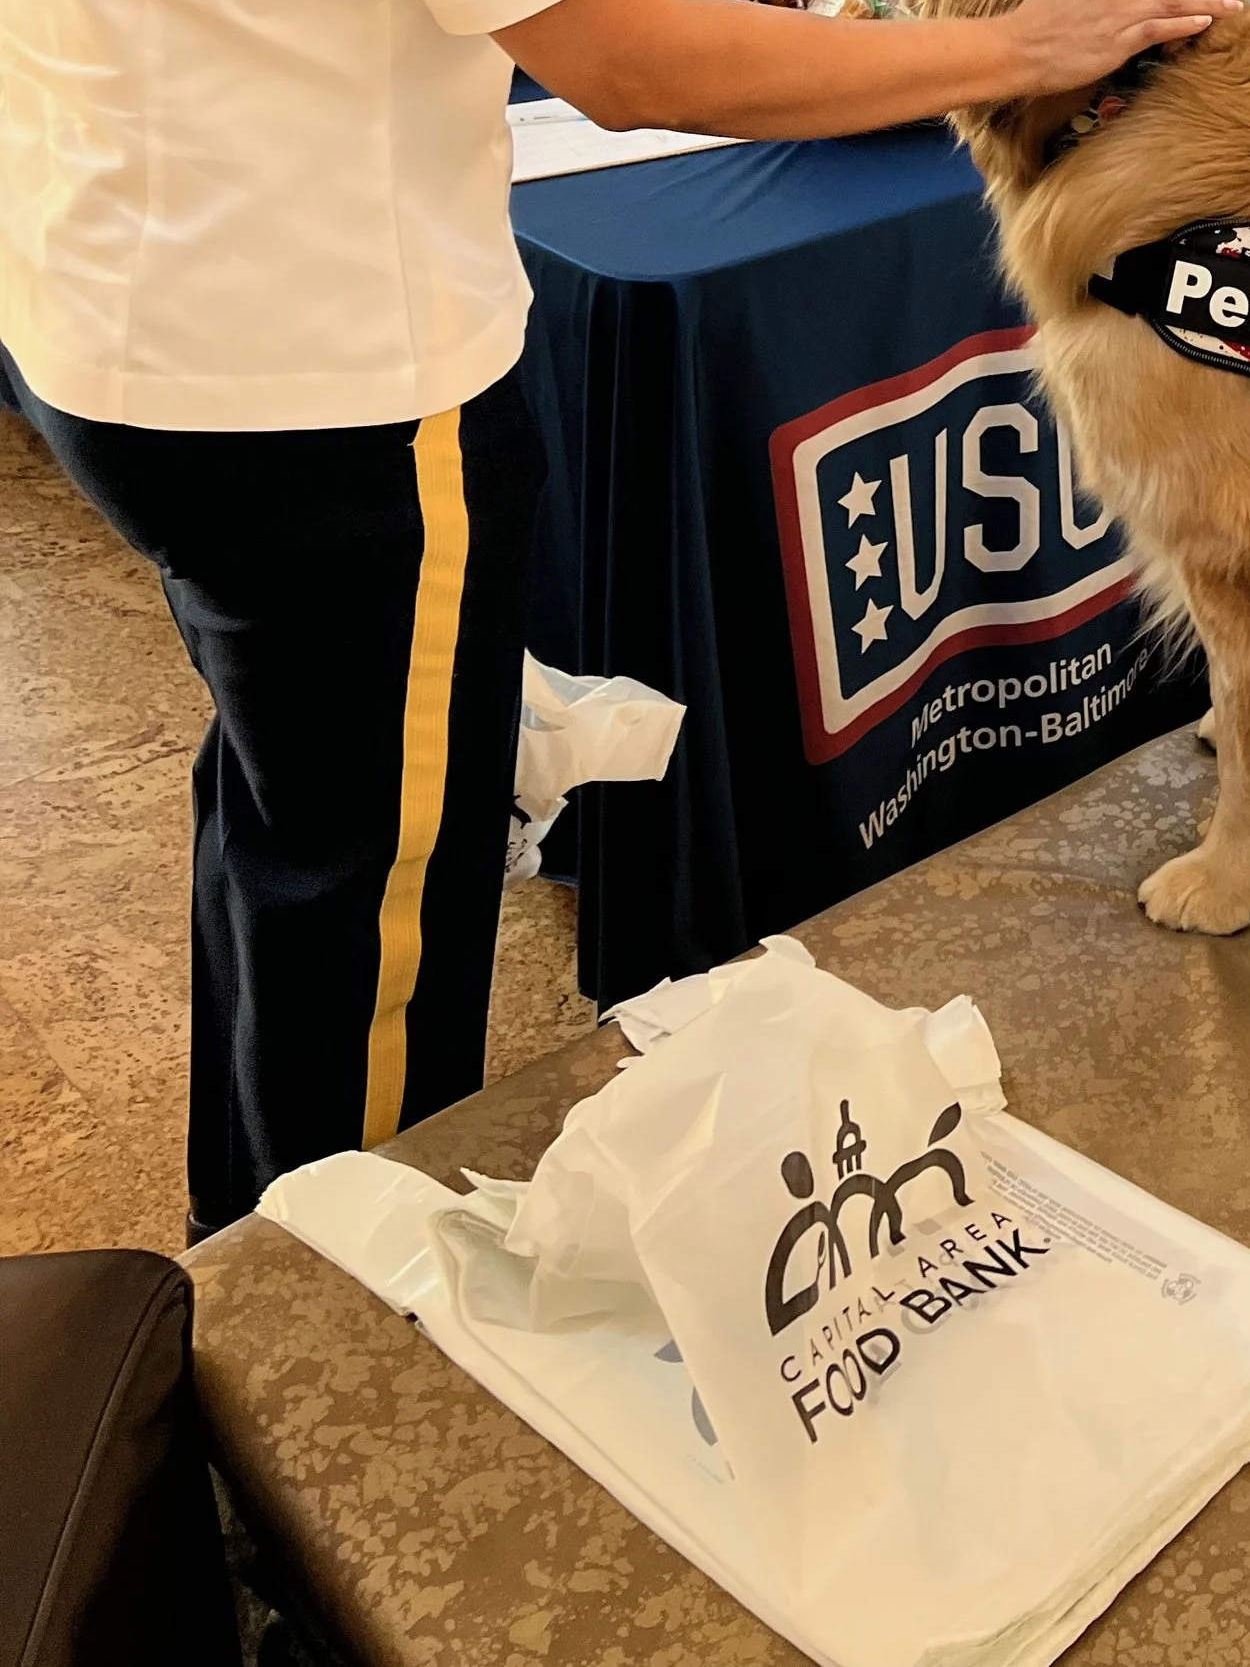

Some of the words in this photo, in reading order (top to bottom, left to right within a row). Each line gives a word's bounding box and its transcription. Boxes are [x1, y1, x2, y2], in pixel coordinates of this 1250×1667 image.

[910, 642, 1113, 749] Metropolitan
[780, 1286, 896, 1382] CAPITAL
[917, 1211, 1012, 1278] AREA
[791, 1327, 901, 1445] FOOD
[899, 1228, 1051, 1324] BANK
